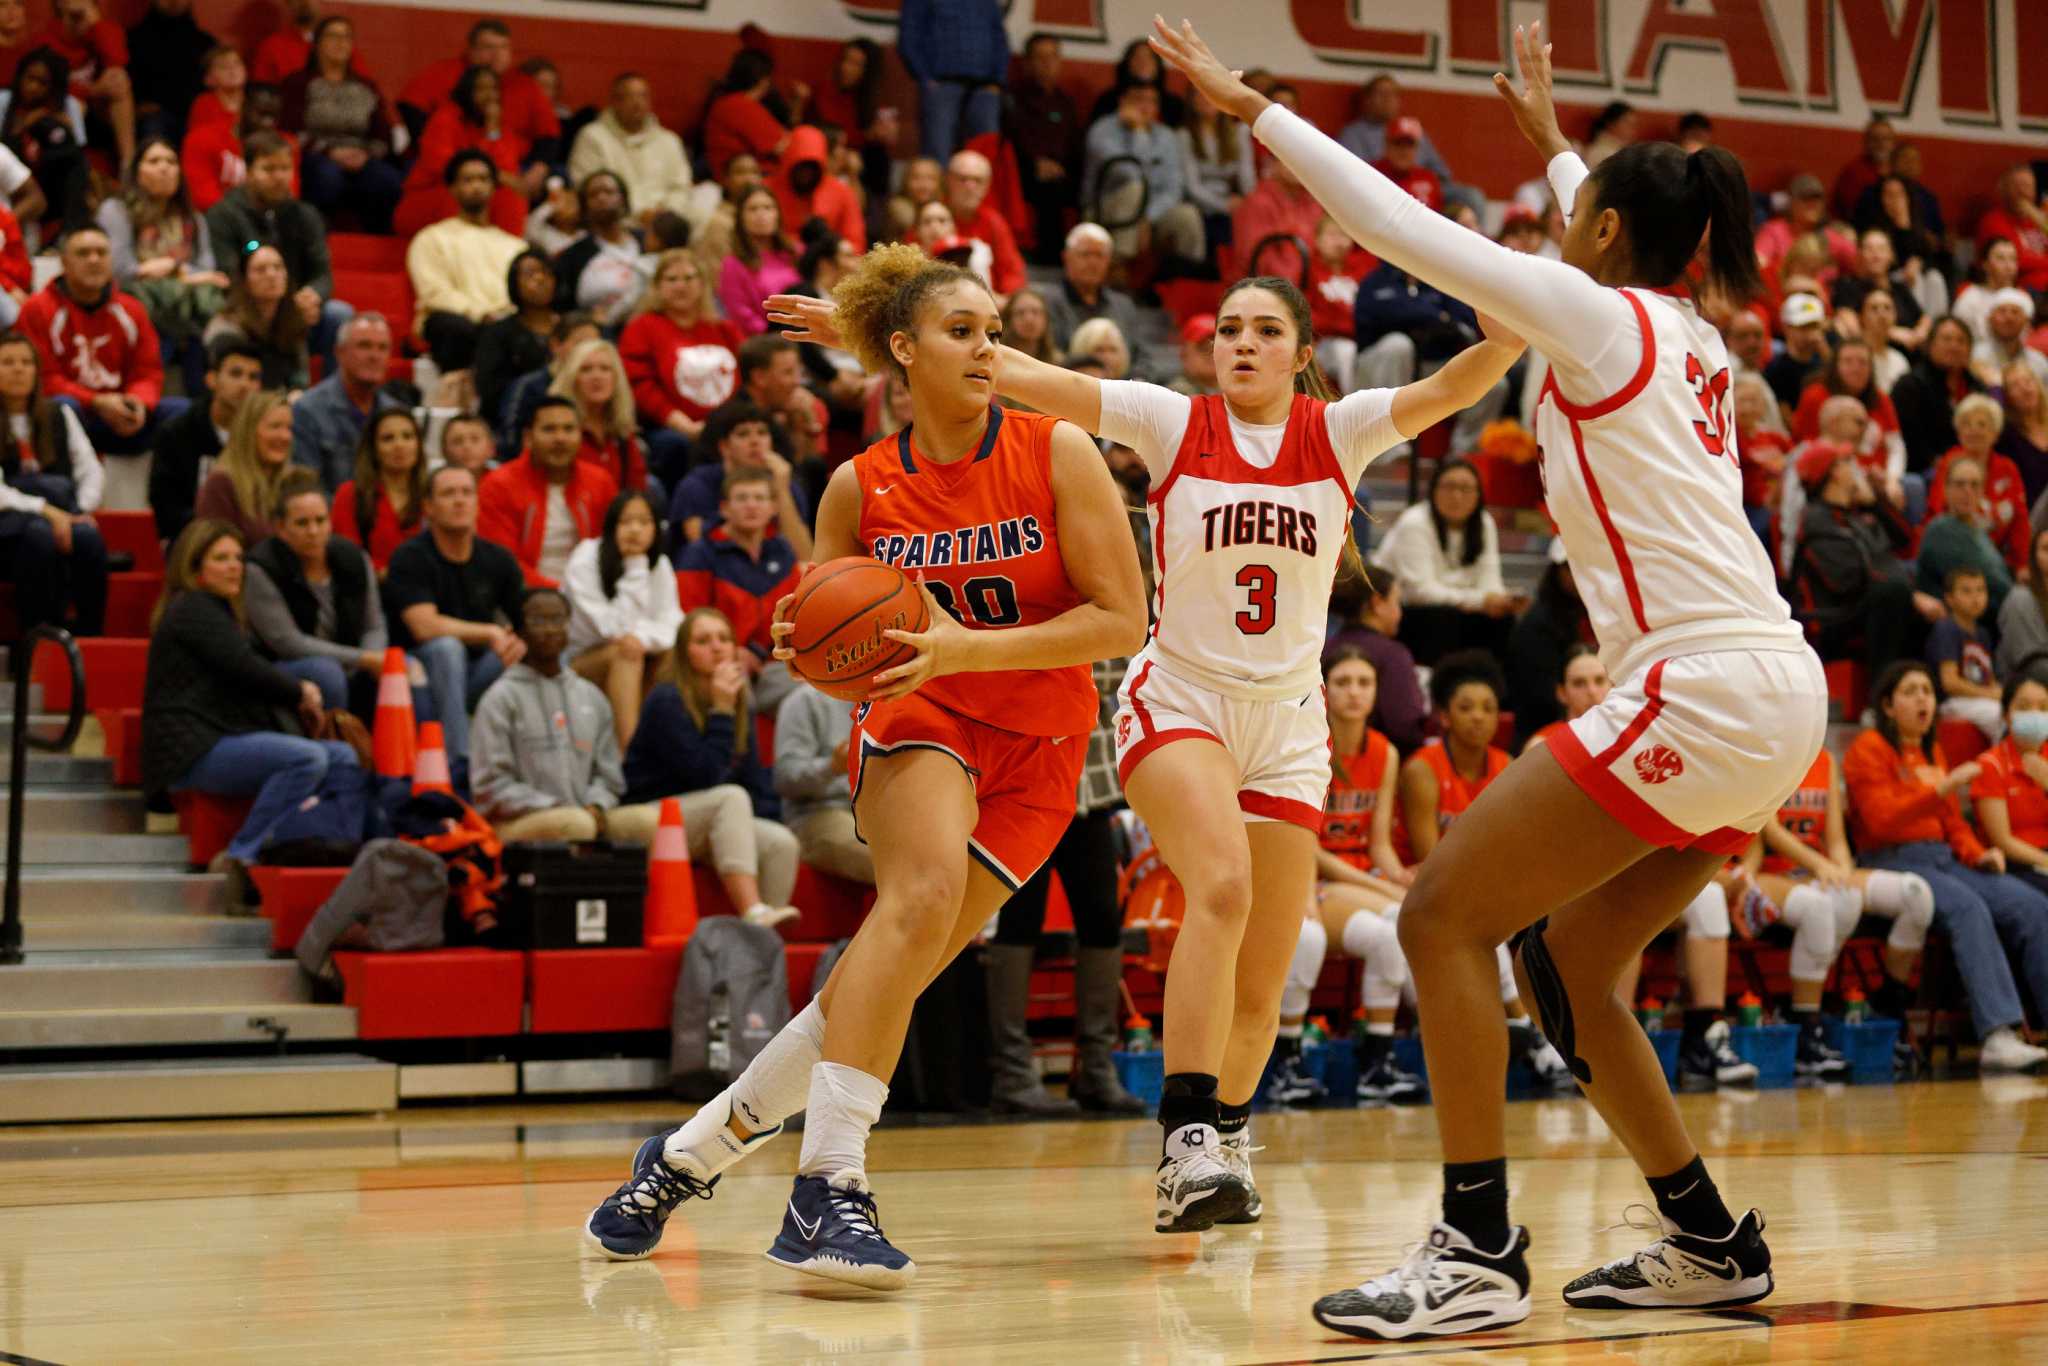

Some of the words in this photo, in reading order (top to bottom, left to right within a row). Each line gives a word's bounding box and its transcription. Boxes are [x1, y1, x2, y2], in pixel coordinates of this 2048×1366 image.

[873, 514, 1044, 569] SPARTANS
[1202, 500, 1317, 557] TIGERS
[1235, 564, 1278, 635] 3
